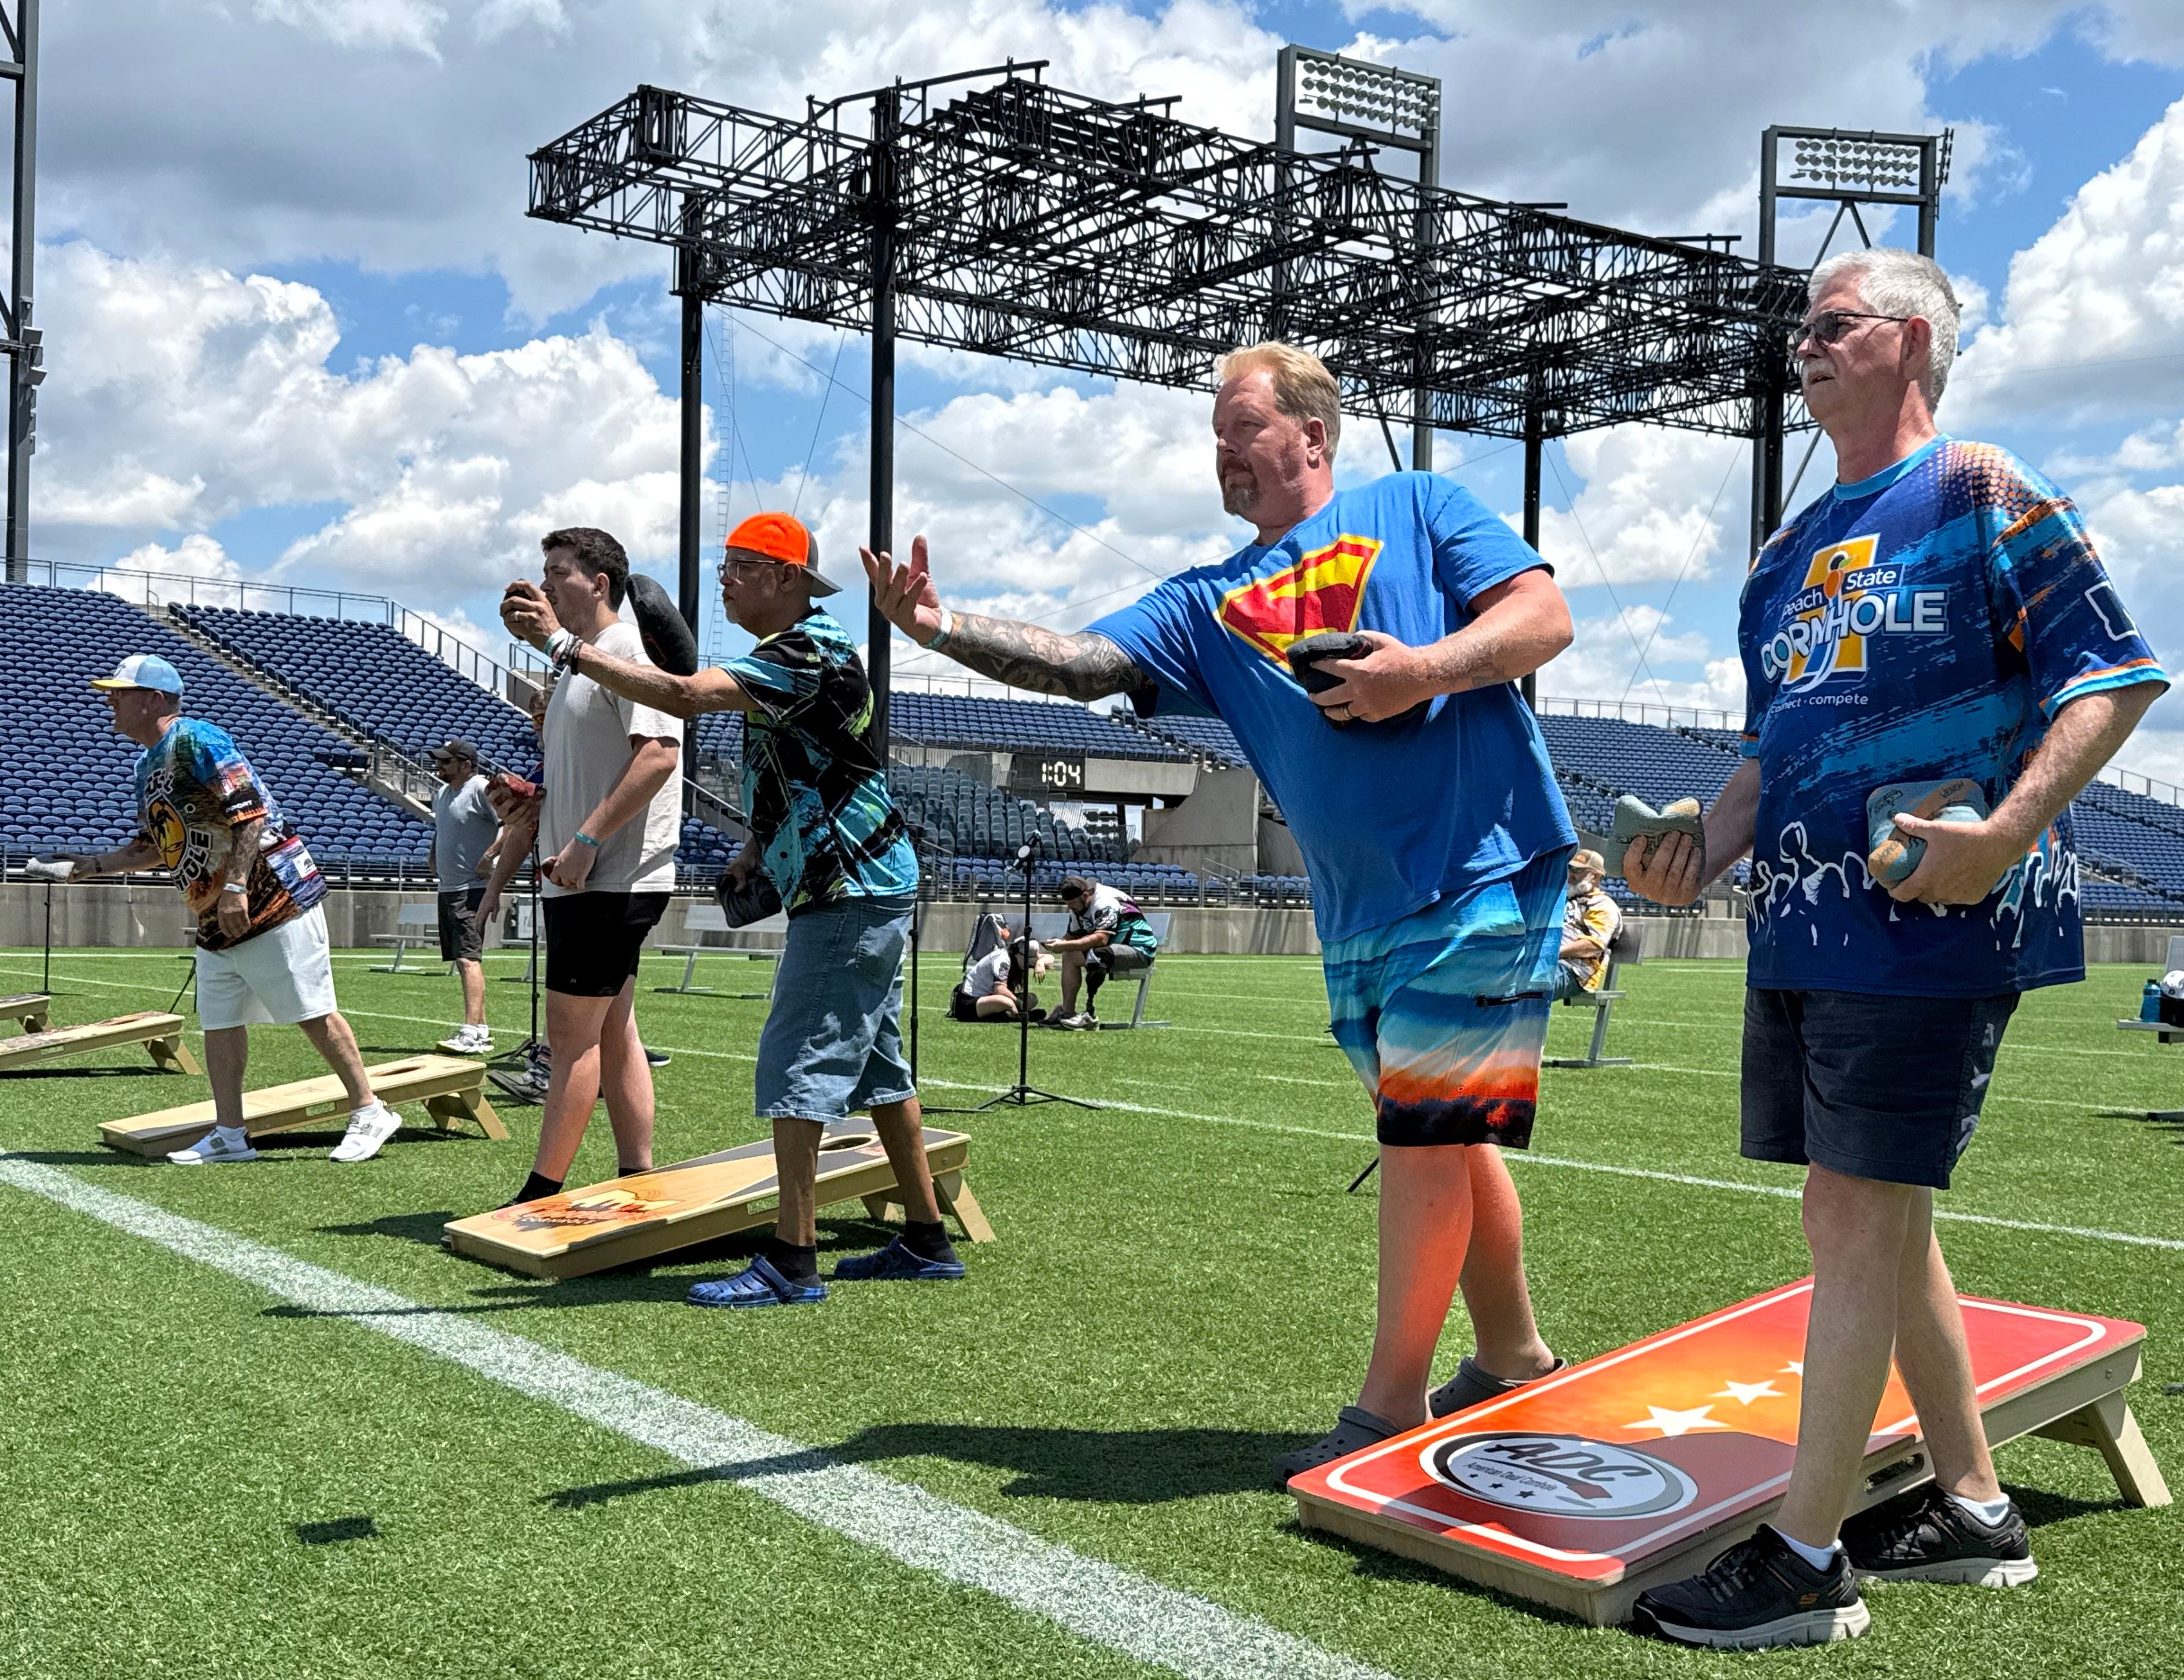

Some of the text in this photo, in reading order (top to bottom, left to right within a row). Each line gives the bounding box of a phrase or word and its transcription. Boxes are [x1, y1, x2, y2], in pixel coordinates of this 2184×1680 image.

[1845, 569, 1897, 591] State
[1760, 591, 1946, 680] CORNHOLE
[1809, 693, 1869, 707] compete
[1042, 761, 1080, 786] 1:04
[1484, 1442, 1653, 1482] ADC
